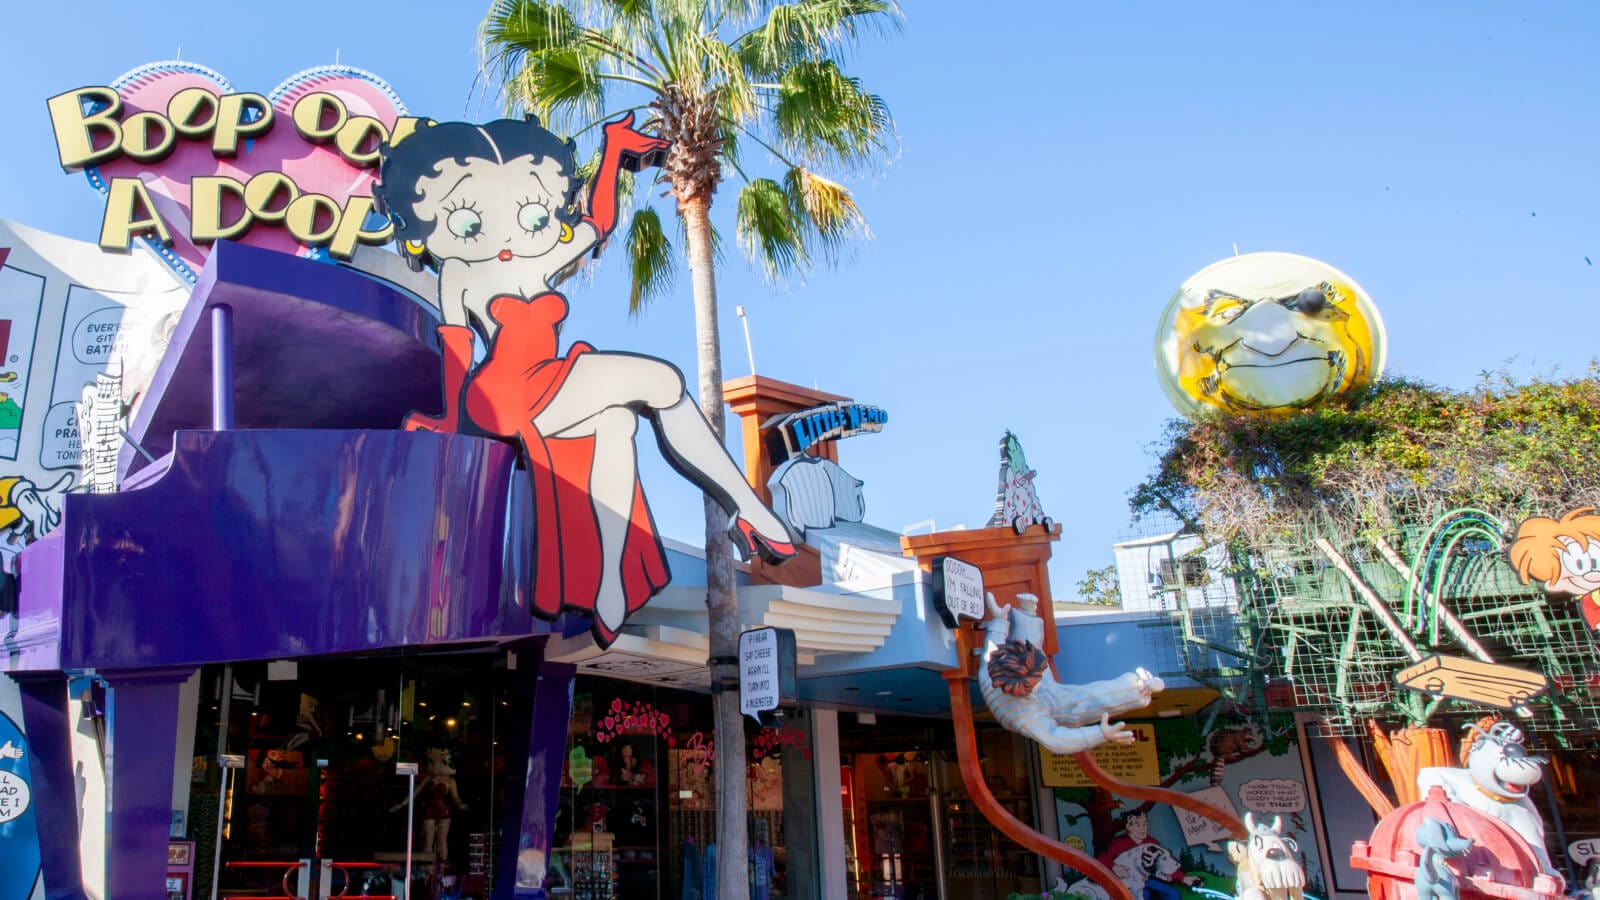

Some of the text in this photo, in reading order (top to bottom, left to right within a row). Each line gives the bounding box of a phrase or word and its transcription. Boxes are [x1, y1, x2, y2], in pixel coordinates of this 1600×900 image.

[100, 176, 173, 253] A
[95, 333, 114, 343] GIT
[792, 404, 888, 450] LITTLE NEMO
[68, 440, 82, 449] HE
[56, 450, 82, 460] TONI
[947, 595, 959, 609] OUT
[961, 599, 968, 610] OF
